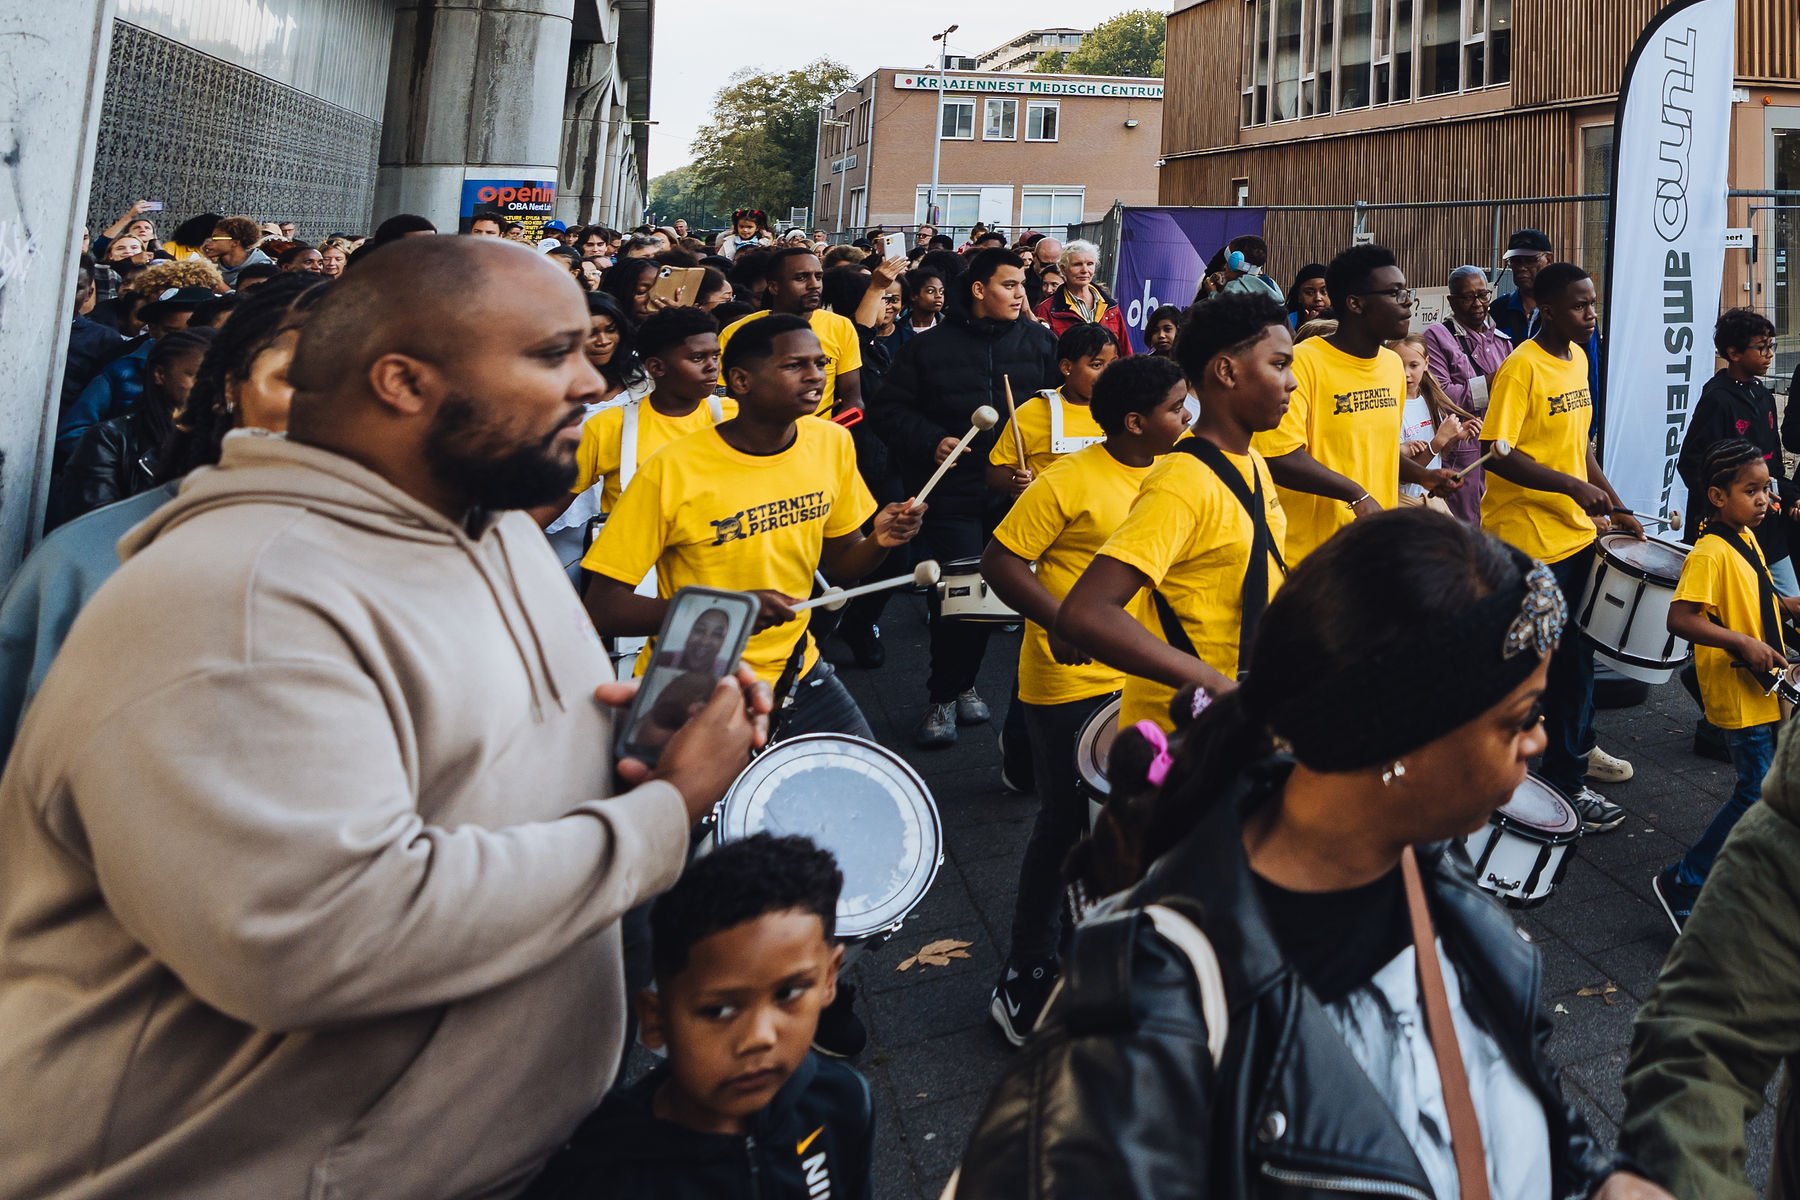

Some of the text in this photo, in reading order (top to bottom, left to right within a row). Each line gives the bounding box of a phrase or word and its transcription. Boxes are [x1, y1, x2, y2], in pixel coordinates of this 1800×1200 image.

[1029, 81, 1096, 95] MEDISCH
[1352, 387, 1391, 402] ETERNITY
[1353, 398, 1398, 413] PERCUSSION
[746, 490, 825, 523] ETERNITY
